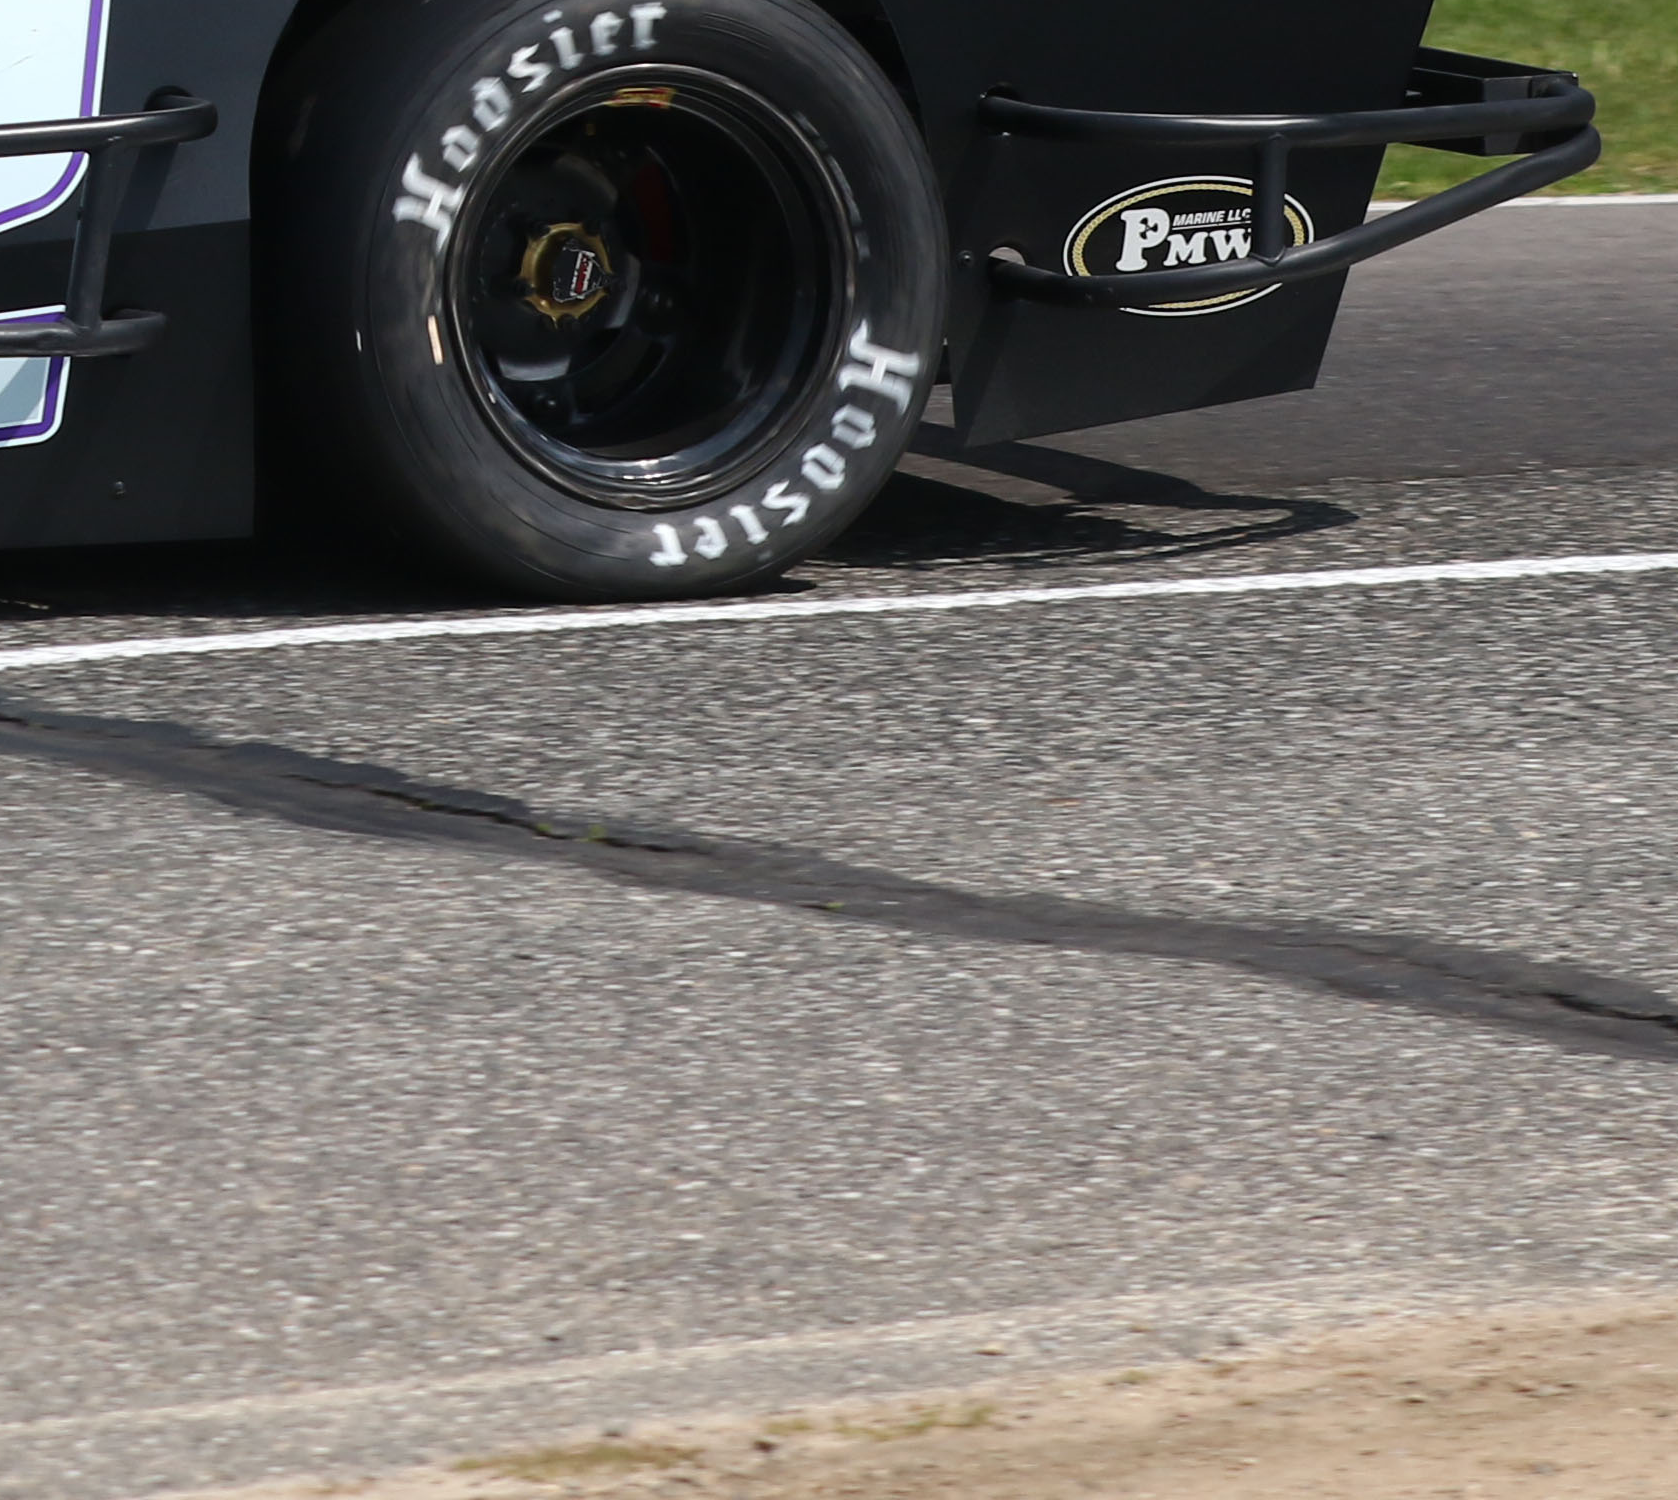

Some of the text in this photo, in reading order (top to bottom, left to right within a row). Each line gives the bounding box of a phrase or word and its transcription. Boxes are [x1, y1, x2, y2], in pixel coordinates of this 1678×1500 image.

[392, 0, 668, 254] Hoosier
[1115, 207, 1252, 272] PMW
[1172, 210, 1226, 227] MARINE
[648, 319, 920, 568] Hoosier
